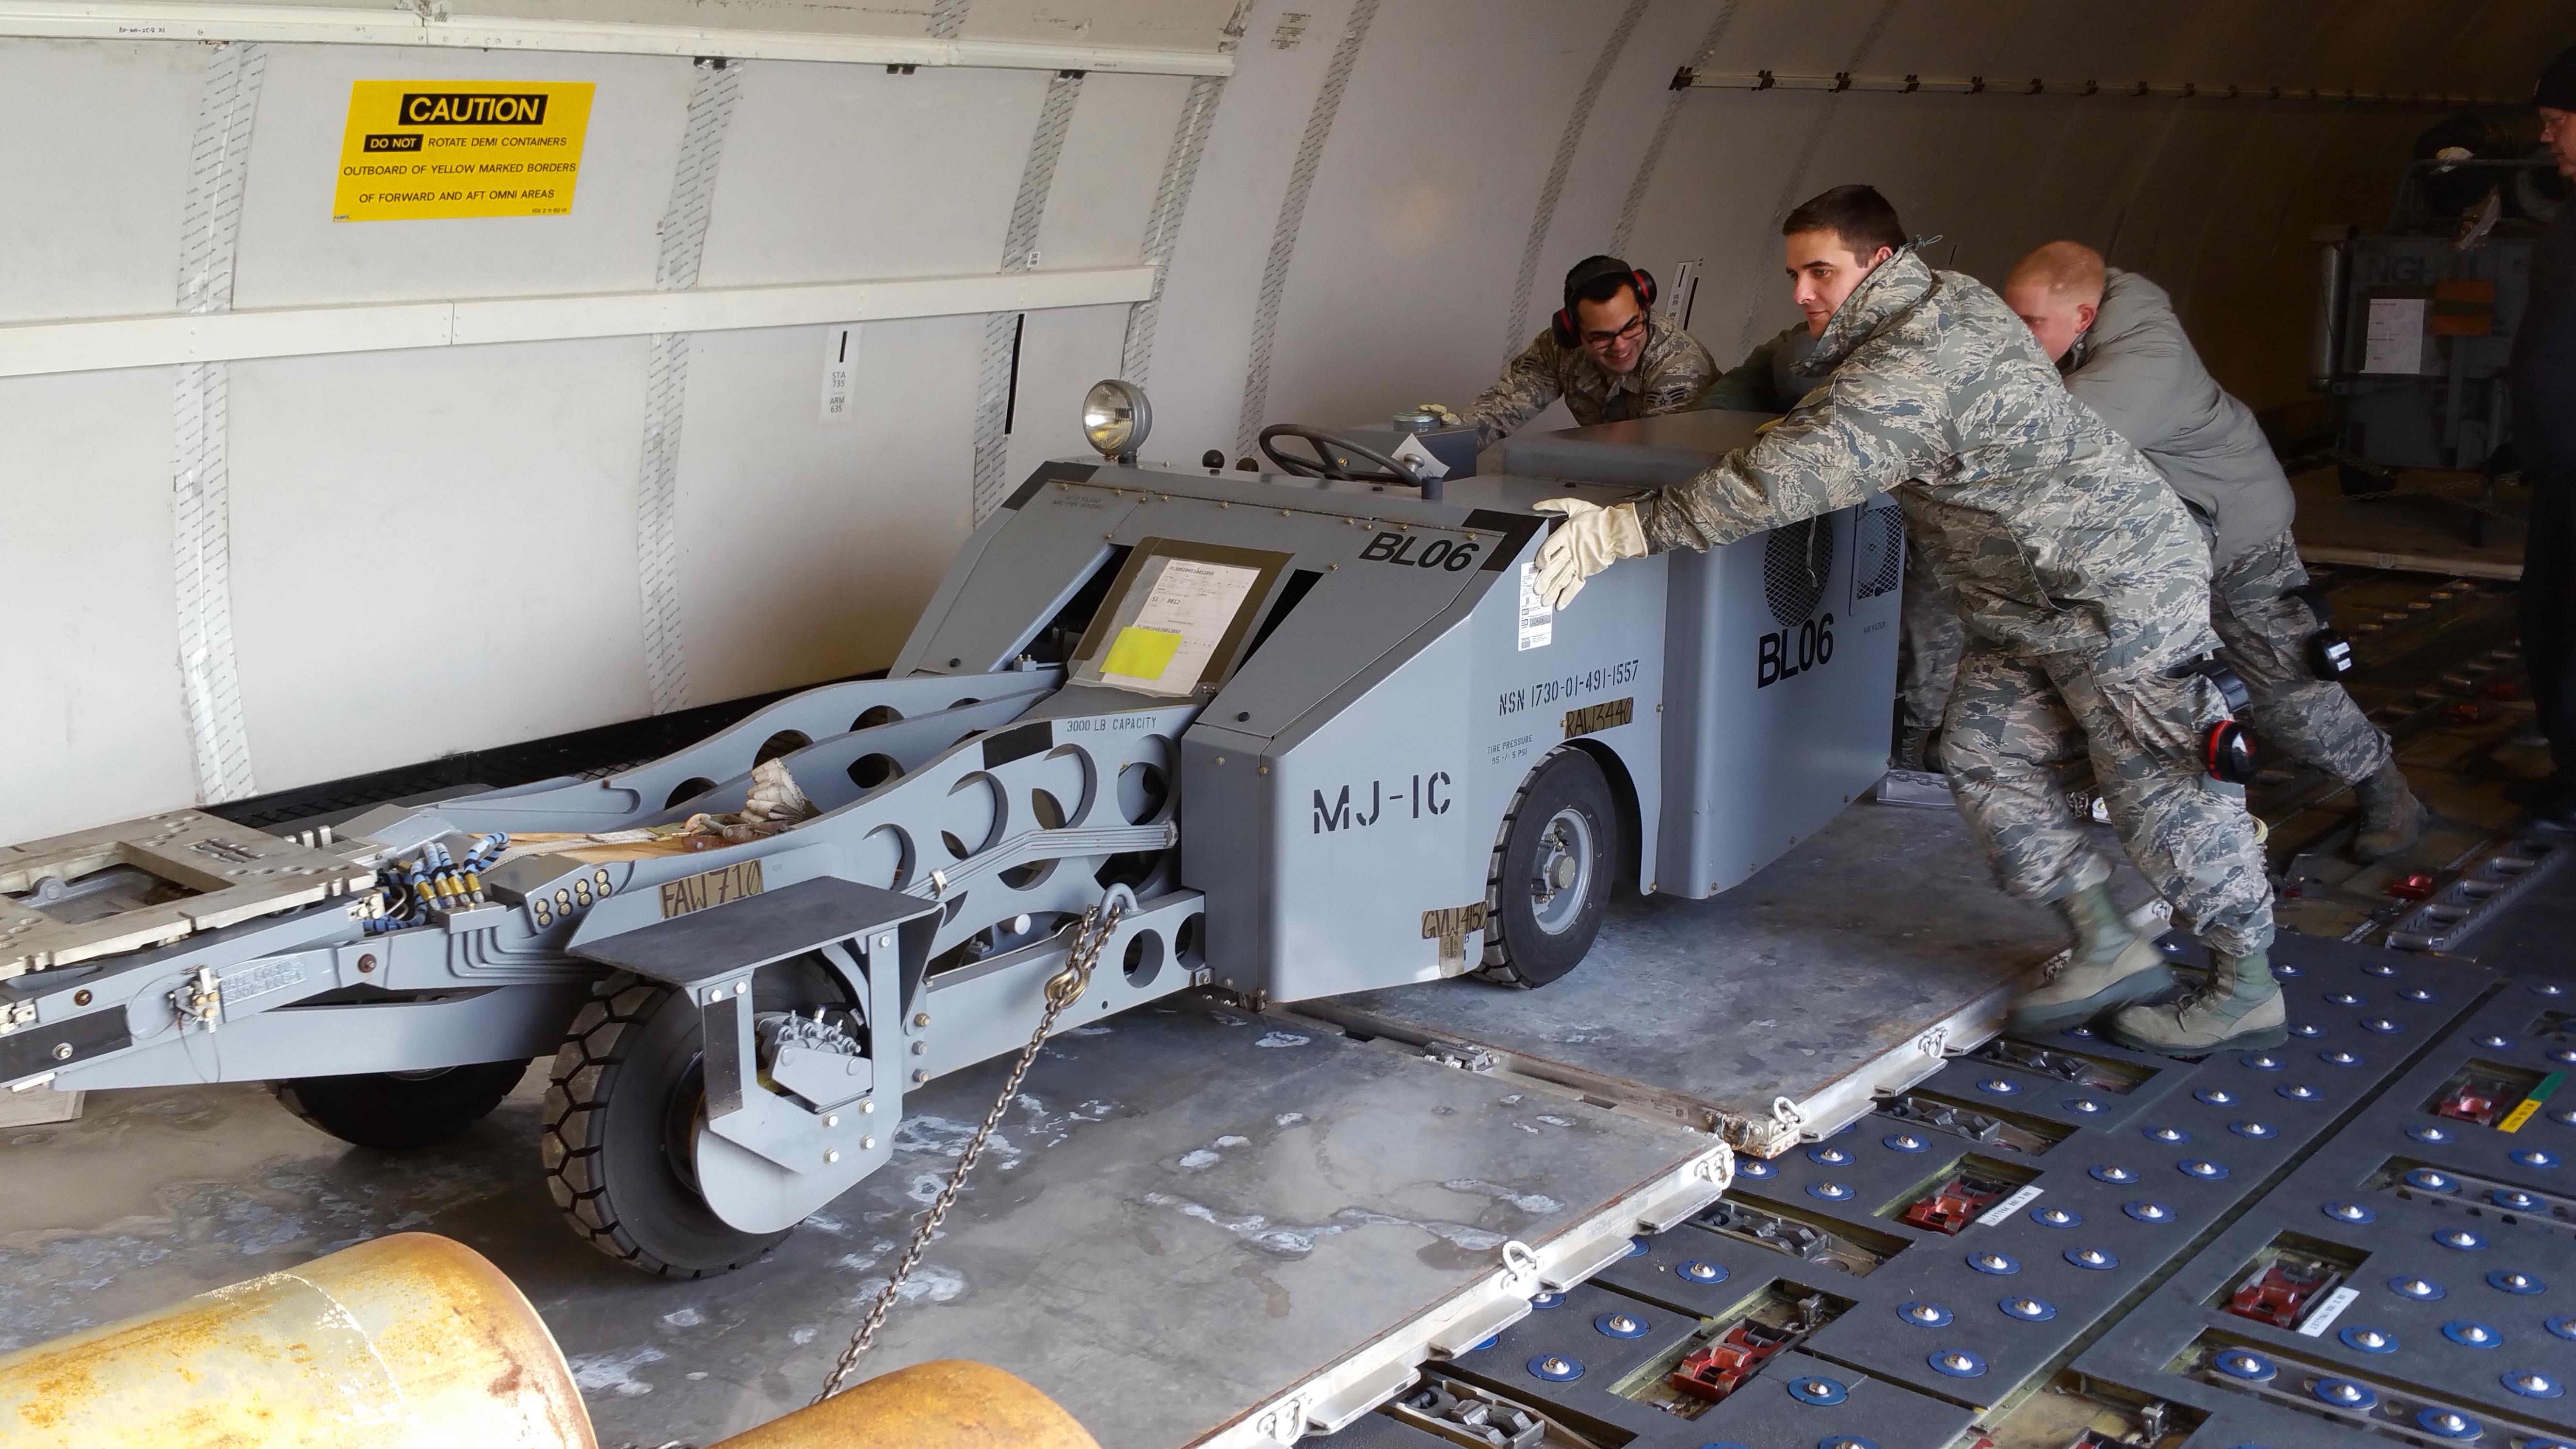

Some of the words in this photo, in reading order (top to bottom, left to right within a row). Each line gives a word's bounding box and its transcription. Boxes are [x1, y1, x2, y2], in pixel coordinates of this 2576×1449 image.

[409, 97, 539, 122] CAUTION
[370, 138, 389, 148] DO
[392, 138, 418, 148] NOT
[428, 138, 467, 147] ROTATE
[471, 138, 498, 146] DEMI
[501, 137, 567, 146] CONTAINERS
[343, 166, 407, 176] OUTBOARD
[411, 165, 428, 174] OF
[431, 164, 475, 174] YELLOW
[479, 163, 523, 173] MARKED
[527, 163, 577, 172] BORDERS
[359, 193, 375, 203] OF
[378, 192, 435, 202] FORWARD
[439, 191, 463, 200] AND
[466, 191, 486, 200] AFT
[489, 190, 517, 199] OMNI
[520, 189, 555, 199] AREAS
[832, 371, 846, 380] STA
[833, 380, 845, 388] 735
[830, 396, 845, 405] ARM
[831, 404, 842, 413] 635
[1358, 531, 1480, 571] BL06
[1757, 612, 1834, 689] BL06
[1499, 689, 1525, 716] NSN
[1531, 660, 1639, 708] 1730-01-491-1557
[1067, 720, 1091, 732] 3000
[1094, 719, 1106, 731] LB
[1112, 716, 1157, 730] CAPACITY
[1487, 743, 1501, 754] TIRE
[1502, 734, 1533, 750] PRESSURE
[1492, 756, 1500, 765] 95
[1518, 748, 1528, 757] PSI
[1314, 772, 1450, 834] MJ-1C
[661, 874, 708, 919] FAW
[709, 860, 761, 904] 710
